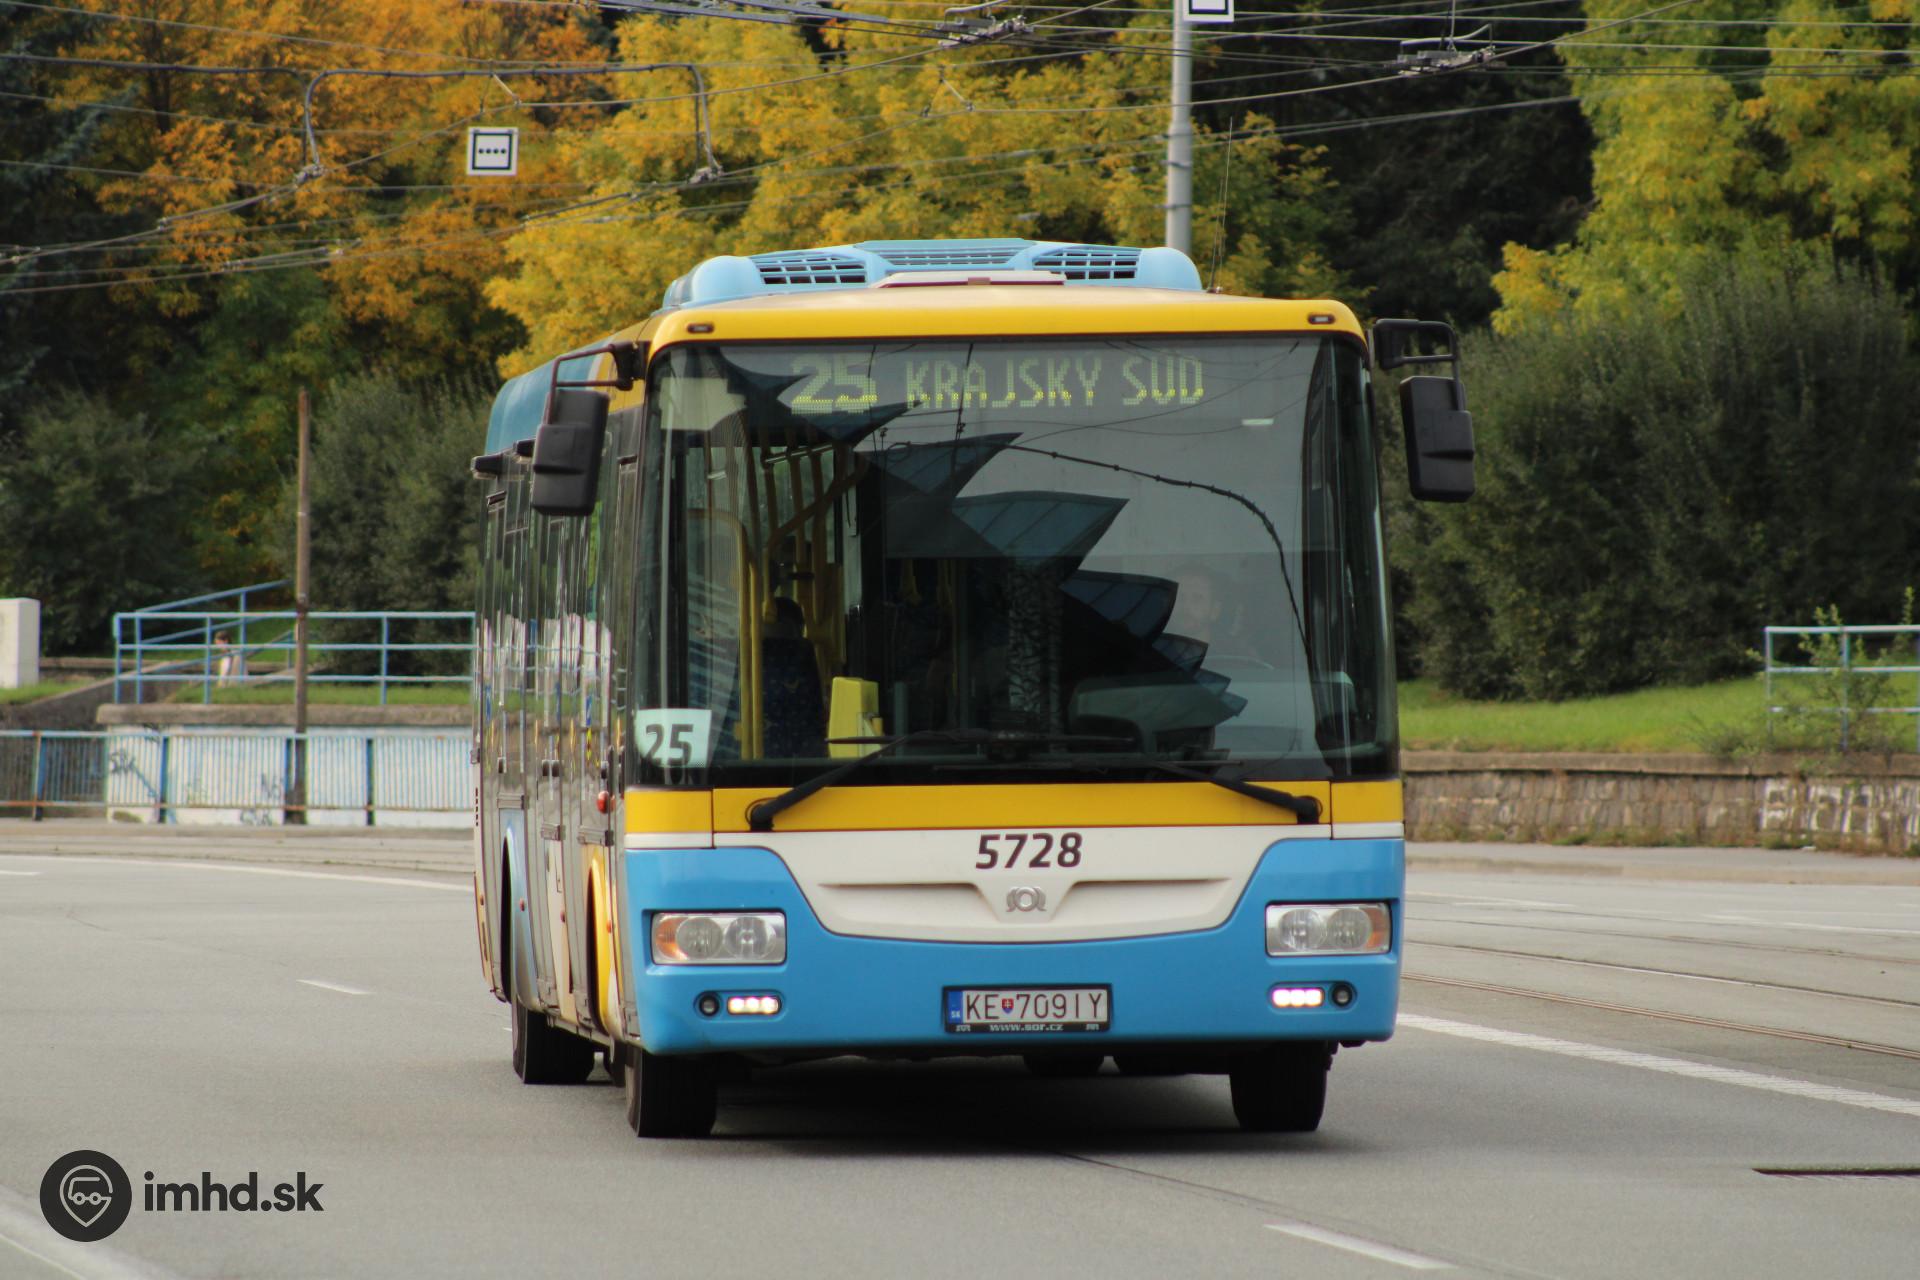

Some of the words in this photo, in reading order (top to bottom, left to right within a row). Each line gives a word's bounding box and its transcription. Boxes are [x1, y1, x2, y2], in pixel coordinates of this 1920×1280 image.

[791, 354, 877, 415] 25
[645, 723, 693, 767] 25
[975, 832, 1082, 869] 5728
[966, 994, 999, 1019] KE
[990, 1023, 1064, 1032] www.sor.cz
